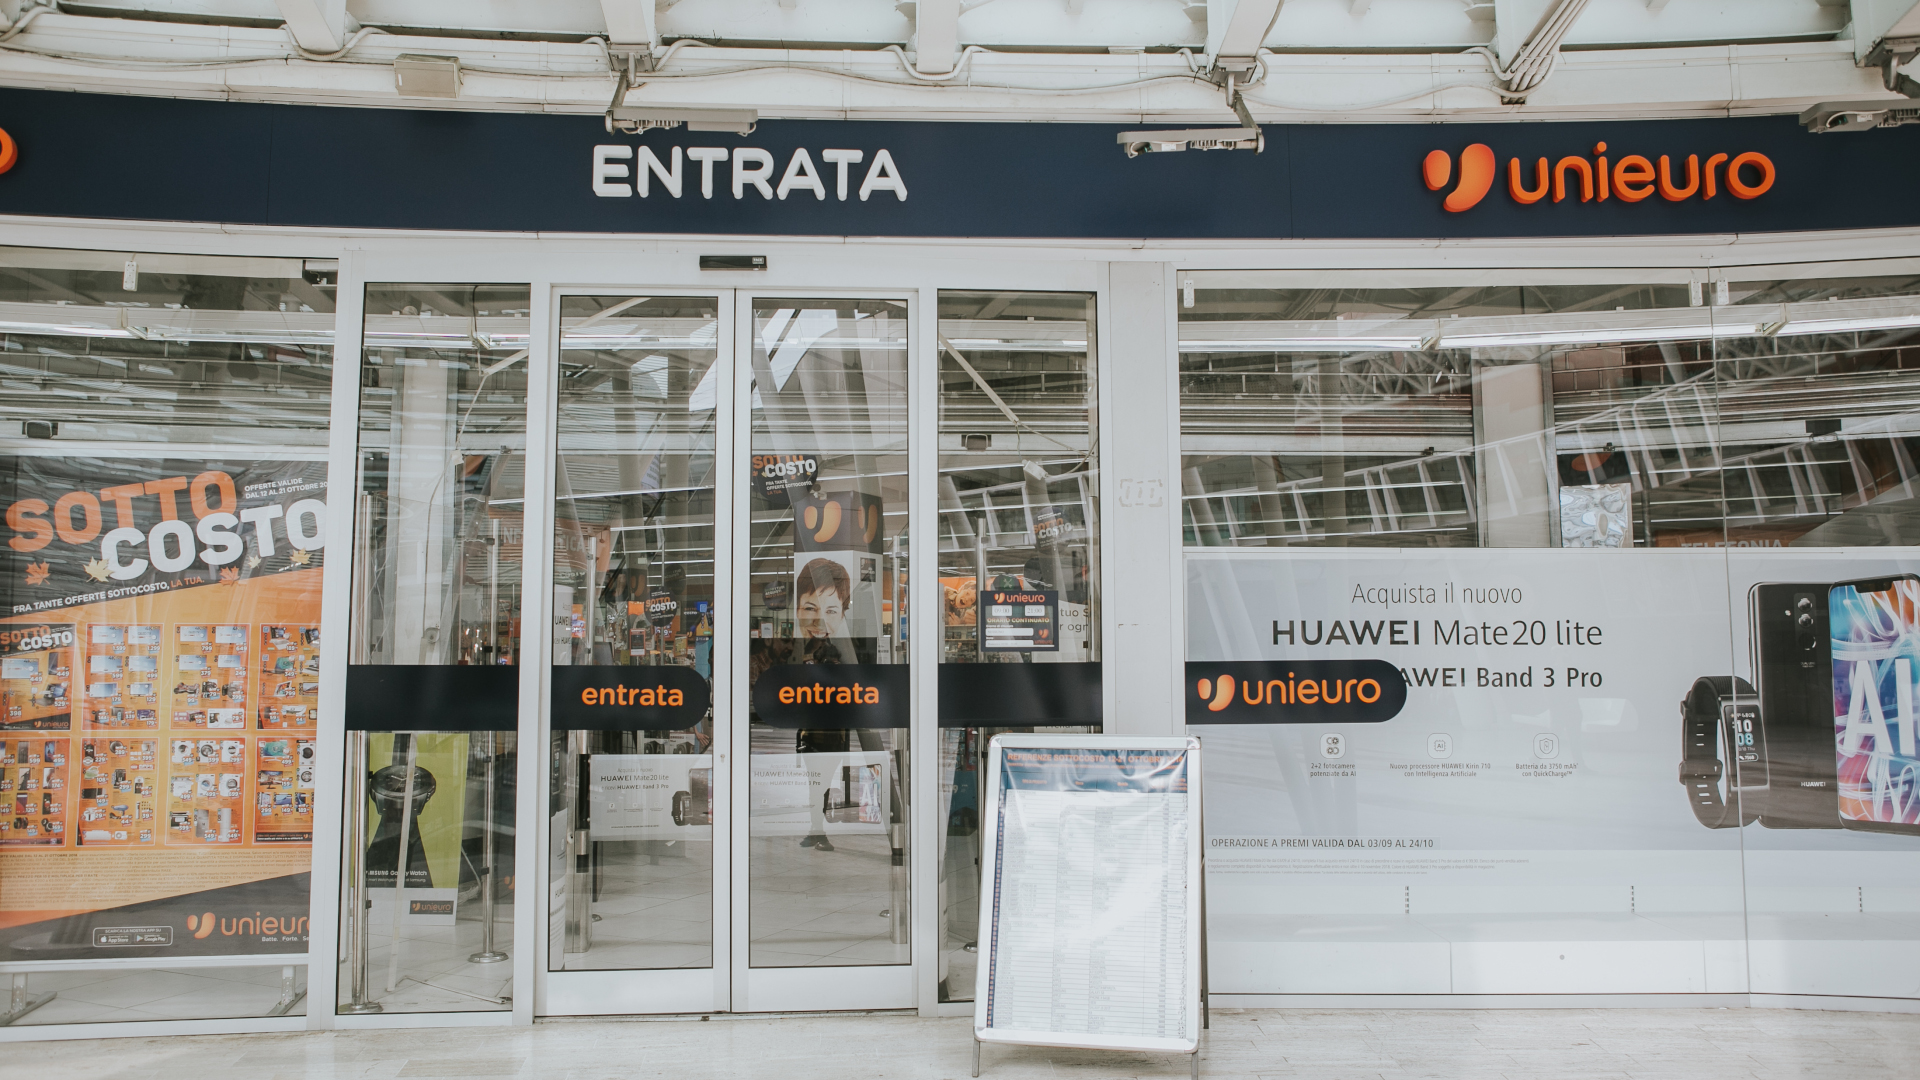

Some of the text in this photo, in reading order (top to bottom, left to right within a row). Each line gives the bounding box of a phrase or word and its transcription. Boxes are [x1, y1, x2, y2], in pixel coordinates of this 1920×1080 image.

[592, 145, 908, 202] ENTRATA
[1508, 141, 1776, 205] unieuro
[765, 459, 817, 478] COSTO
[244, 477, 303, 492] OFFERTE VALIDE
[245, 491, 259, 499] DAL
[286, 482, 319, 493] OTTOBRE
[5, 470, 237, 552] SOTTO
[100, 498, 328, 580] COSTO
[1039, 522, 1072, 539] COSTO
[13, 603, 33, 614] FRA
[33, 598, 63, 611] TANTE
[64, 591, 106, 606] OFFERTE
[107, 581, 170, 599] SOTTOCOSTO,
[170, 579, 183, 588] LA
[1006, 593, 1046, 603] unieuro
[1351, 581, 1523, 609] Acquista il nuovo
[650, 601, 677, 612] COSTO
[1060, 609, 1079, 617] tuo
[0, 625, 51, 645] SOTTO
[20, 631, 73, 651] COSTO
[1272, 619, 1420, 646] HUAWEI
[1556, 618, 1603, 646] lite
[1400, 665, 1603, 688] AWEI Band 3 Pro
[581, 684, 684, 707] entrata
[778, 682, 880, 705] entrata
[1242, 671, 1382, 705] unieuro
[1736, 719, 1753, 733] 10
[1737, 732, 1754, 747] 08
[1053, 754, 1106, 762] SOTTOCOSTO
[1408, 763, 1440, 771] processore
[1310, 770, 1340, 778] potenziate
[1415, 770, 1448, 779] Intelligenza
[1211, 838, 1434, 848] OPERAZIONE A PREMI VALIDA DAL 03/09 AL 24/10
[421, 903, 451, 911] unieuro
[220, 912, 309, 936] unieur
